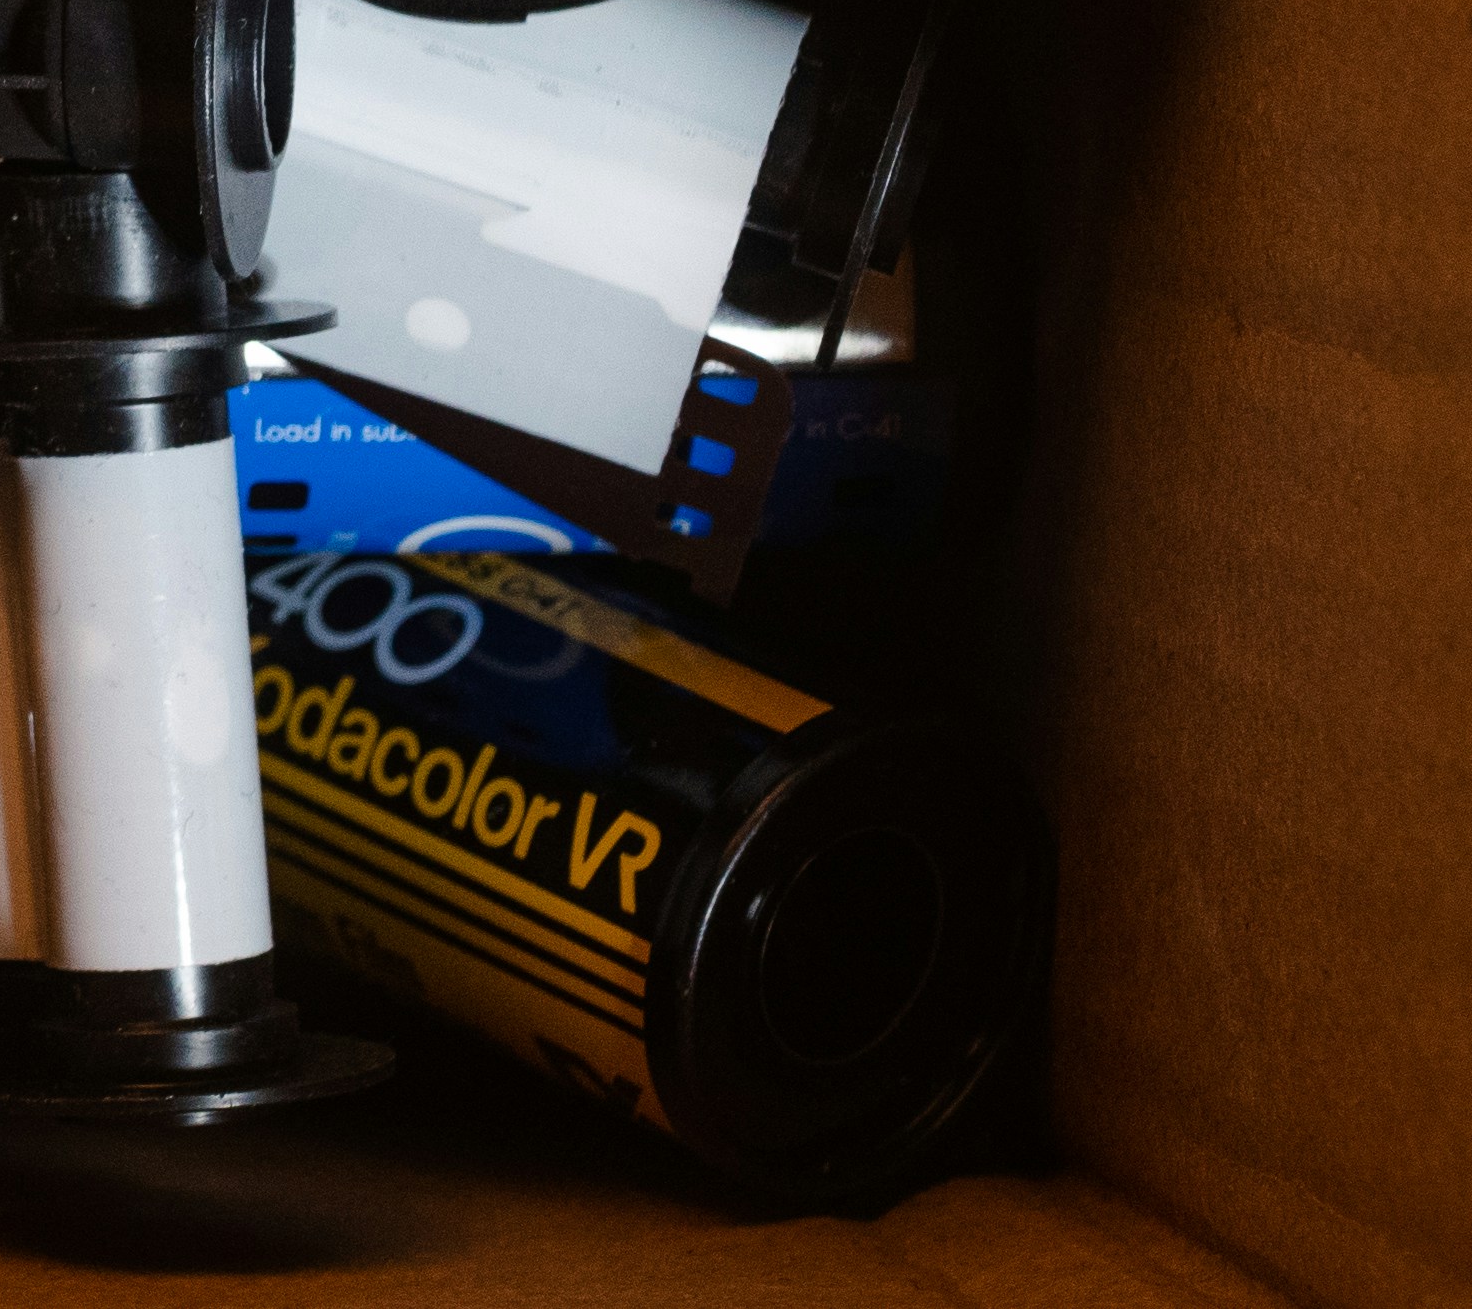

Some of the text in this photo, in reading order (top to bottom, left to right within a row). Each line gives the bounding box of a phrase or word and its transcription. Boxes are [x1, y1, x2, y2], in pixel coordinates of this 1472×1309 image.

[254, 416, 322, 444] Load
[328, 418, 353, 444] in
[251, 551, 485, 688] 400
[251, 671, 664, 915] odacolor VR
